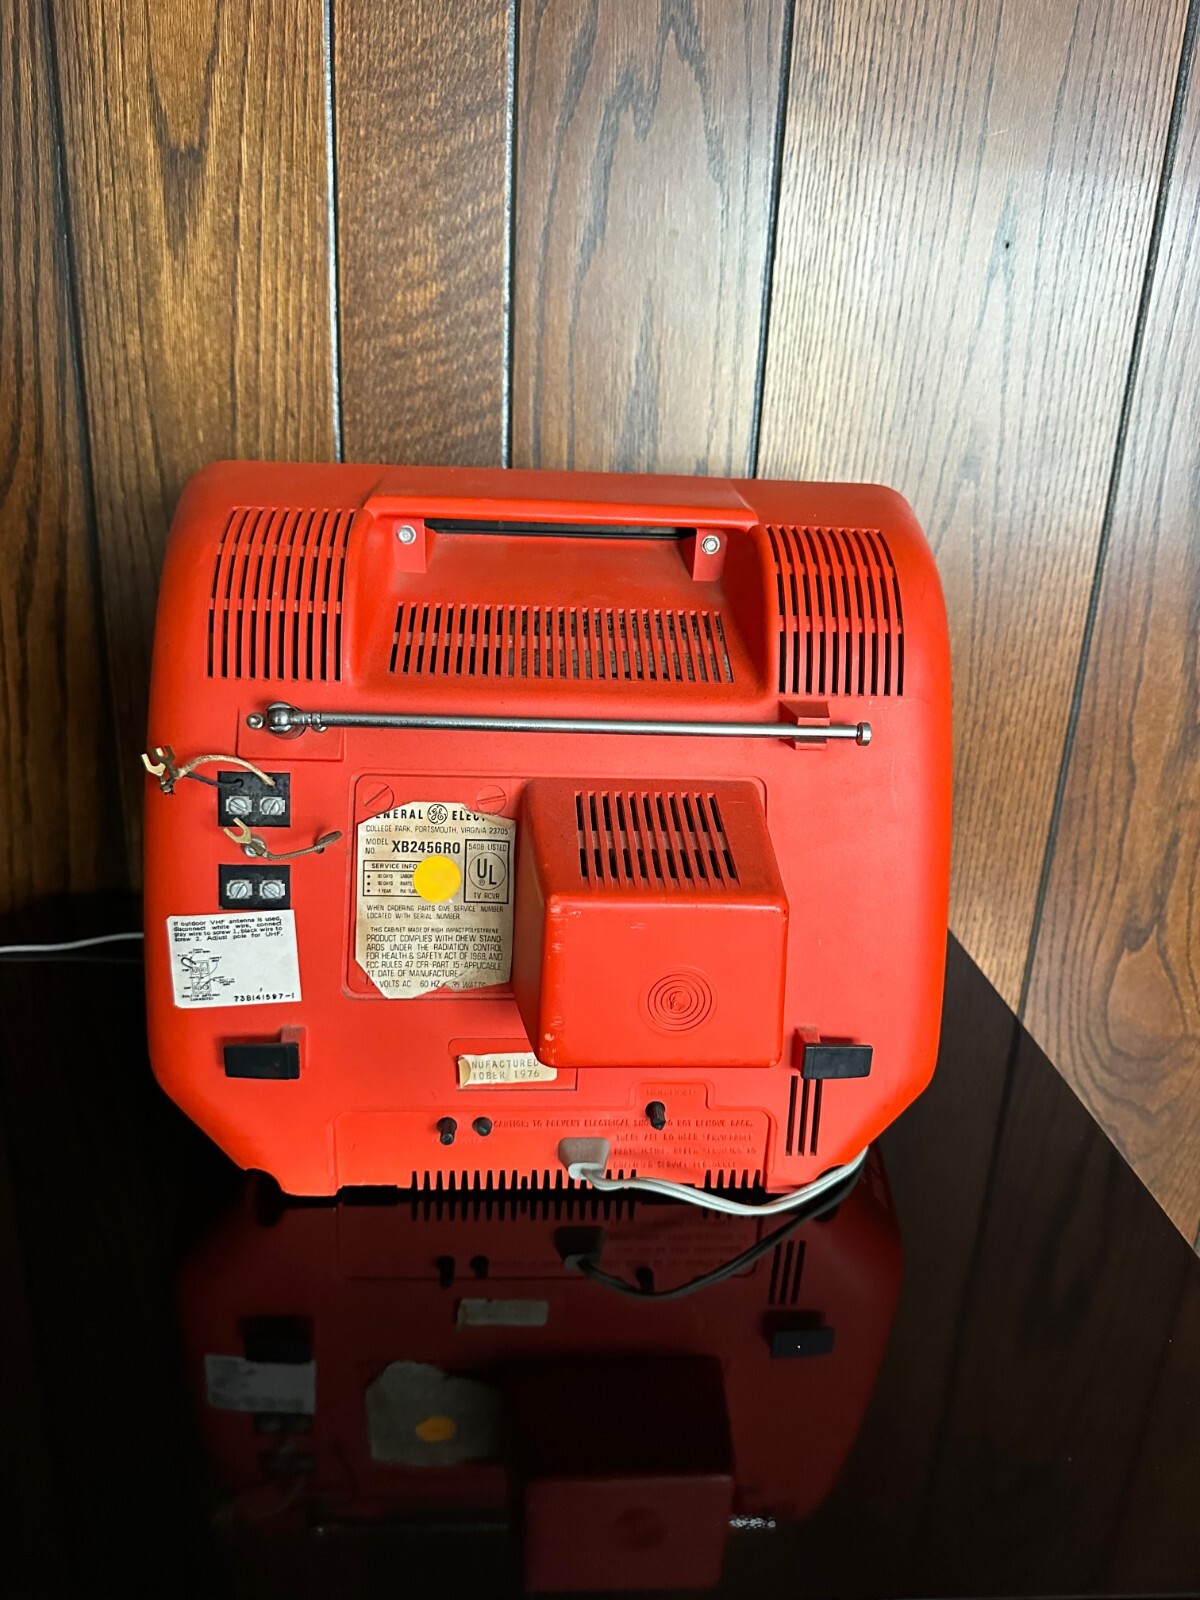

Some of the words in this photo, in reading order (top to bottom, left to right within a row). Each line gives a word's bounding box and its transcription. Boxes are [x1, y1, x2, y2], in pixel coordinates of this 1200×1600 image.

[452, 810, 486, 821] ELEC
[366, 824, 392, 832] COLLEGE
[489, 828, 509, 836] 23705
[488, 844, 507, 852] LISTED
[472, 944, 502, 952] CONTROL
[460, 952, 468, 960] OF
[488, 953, 503, 961] AND
[366, 961, 380, 969] FCC
[378, 970, 395, 978] DATE
